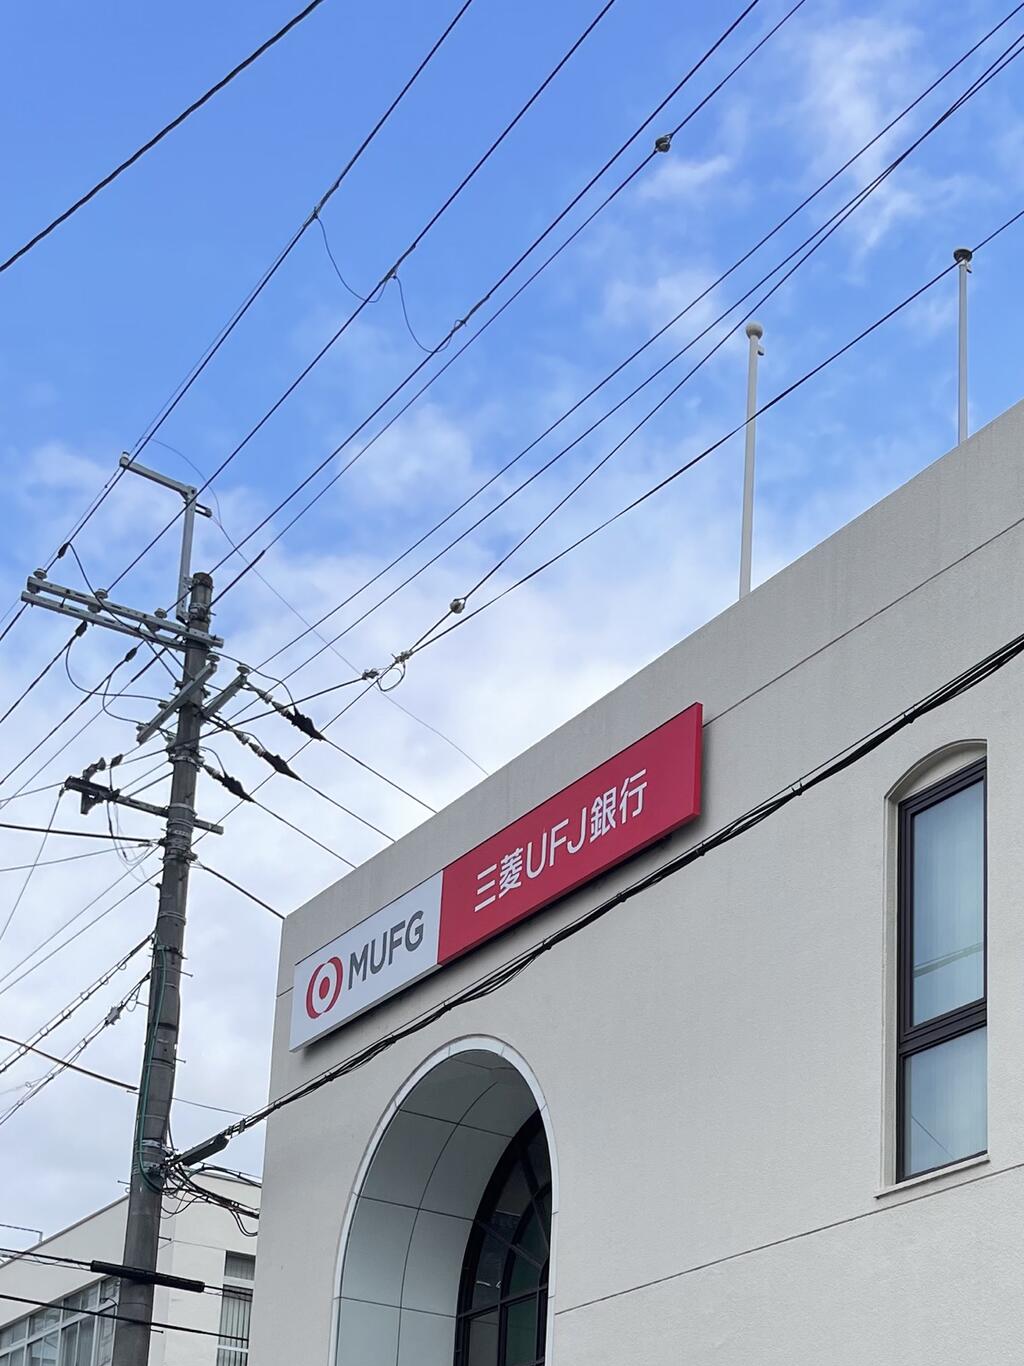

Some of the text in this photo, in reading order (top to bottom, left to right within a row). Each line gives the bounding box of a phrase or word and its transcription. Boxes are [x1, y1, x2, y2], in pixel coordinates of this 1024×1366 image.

[474, 769, 647, 912] 三菱UFJ銀行
[347, 910, 424, 990] MUFG
